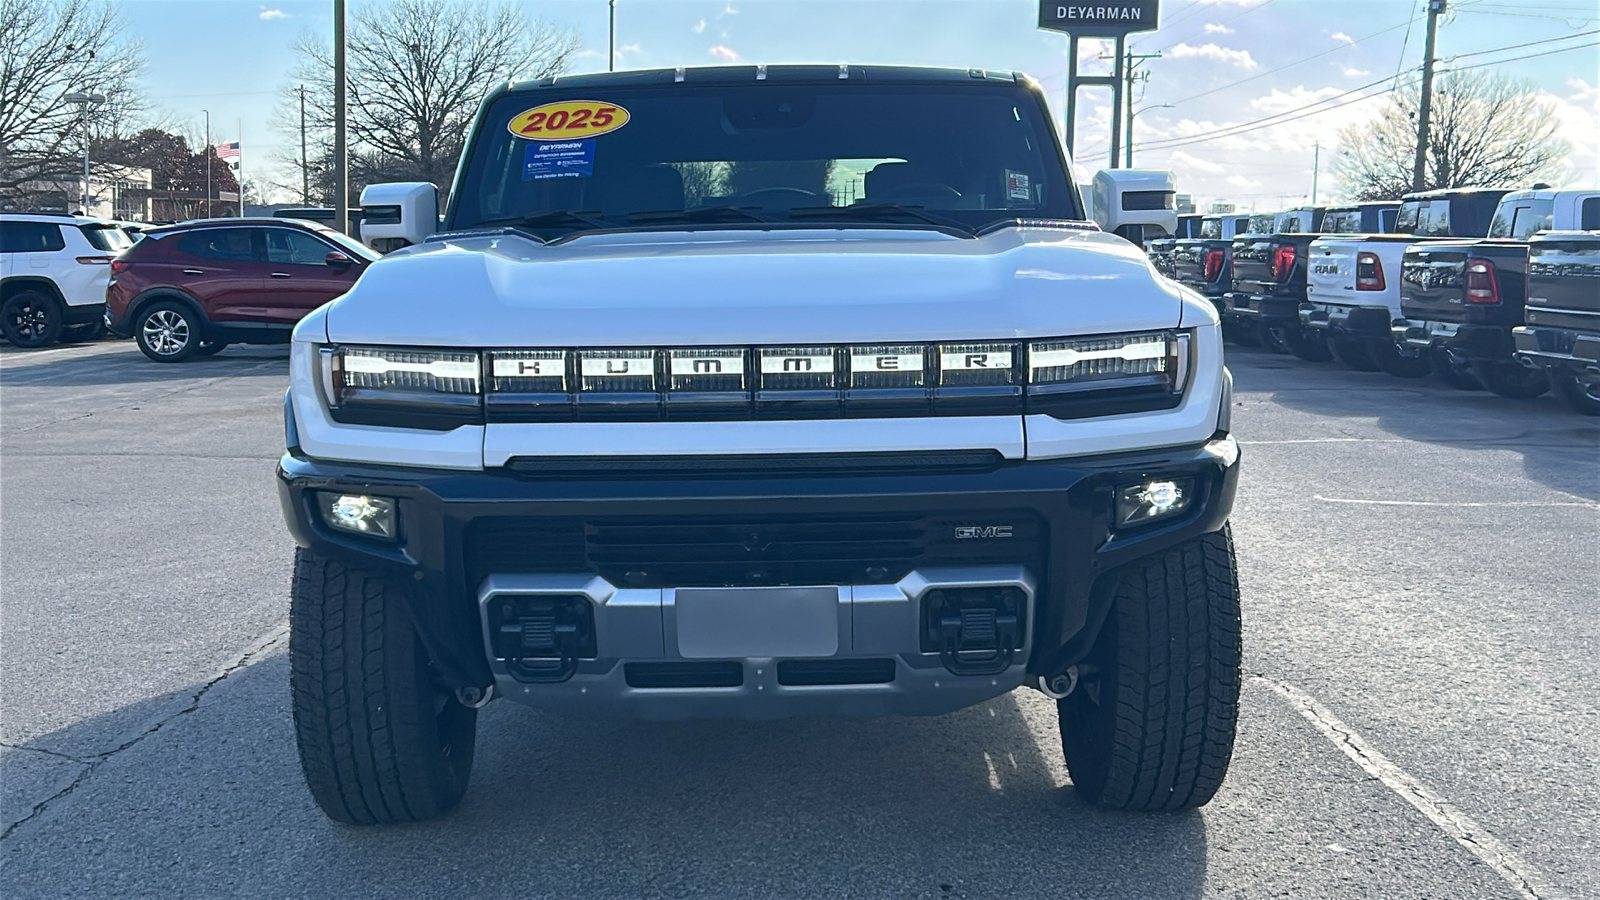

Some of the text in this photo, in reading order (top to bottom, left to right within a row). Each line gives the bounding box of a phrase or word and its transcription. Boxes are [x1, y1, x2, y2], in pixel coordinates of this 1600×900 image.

[1056, 6, 1141, 20] DEYARMAN
[520, 107, 617, 134] 2025
[539, 143, 582, 151] DEYARMAN
[1314, 264, 1339, 275] RAM
[954, 525, 1013, 539] GMC
